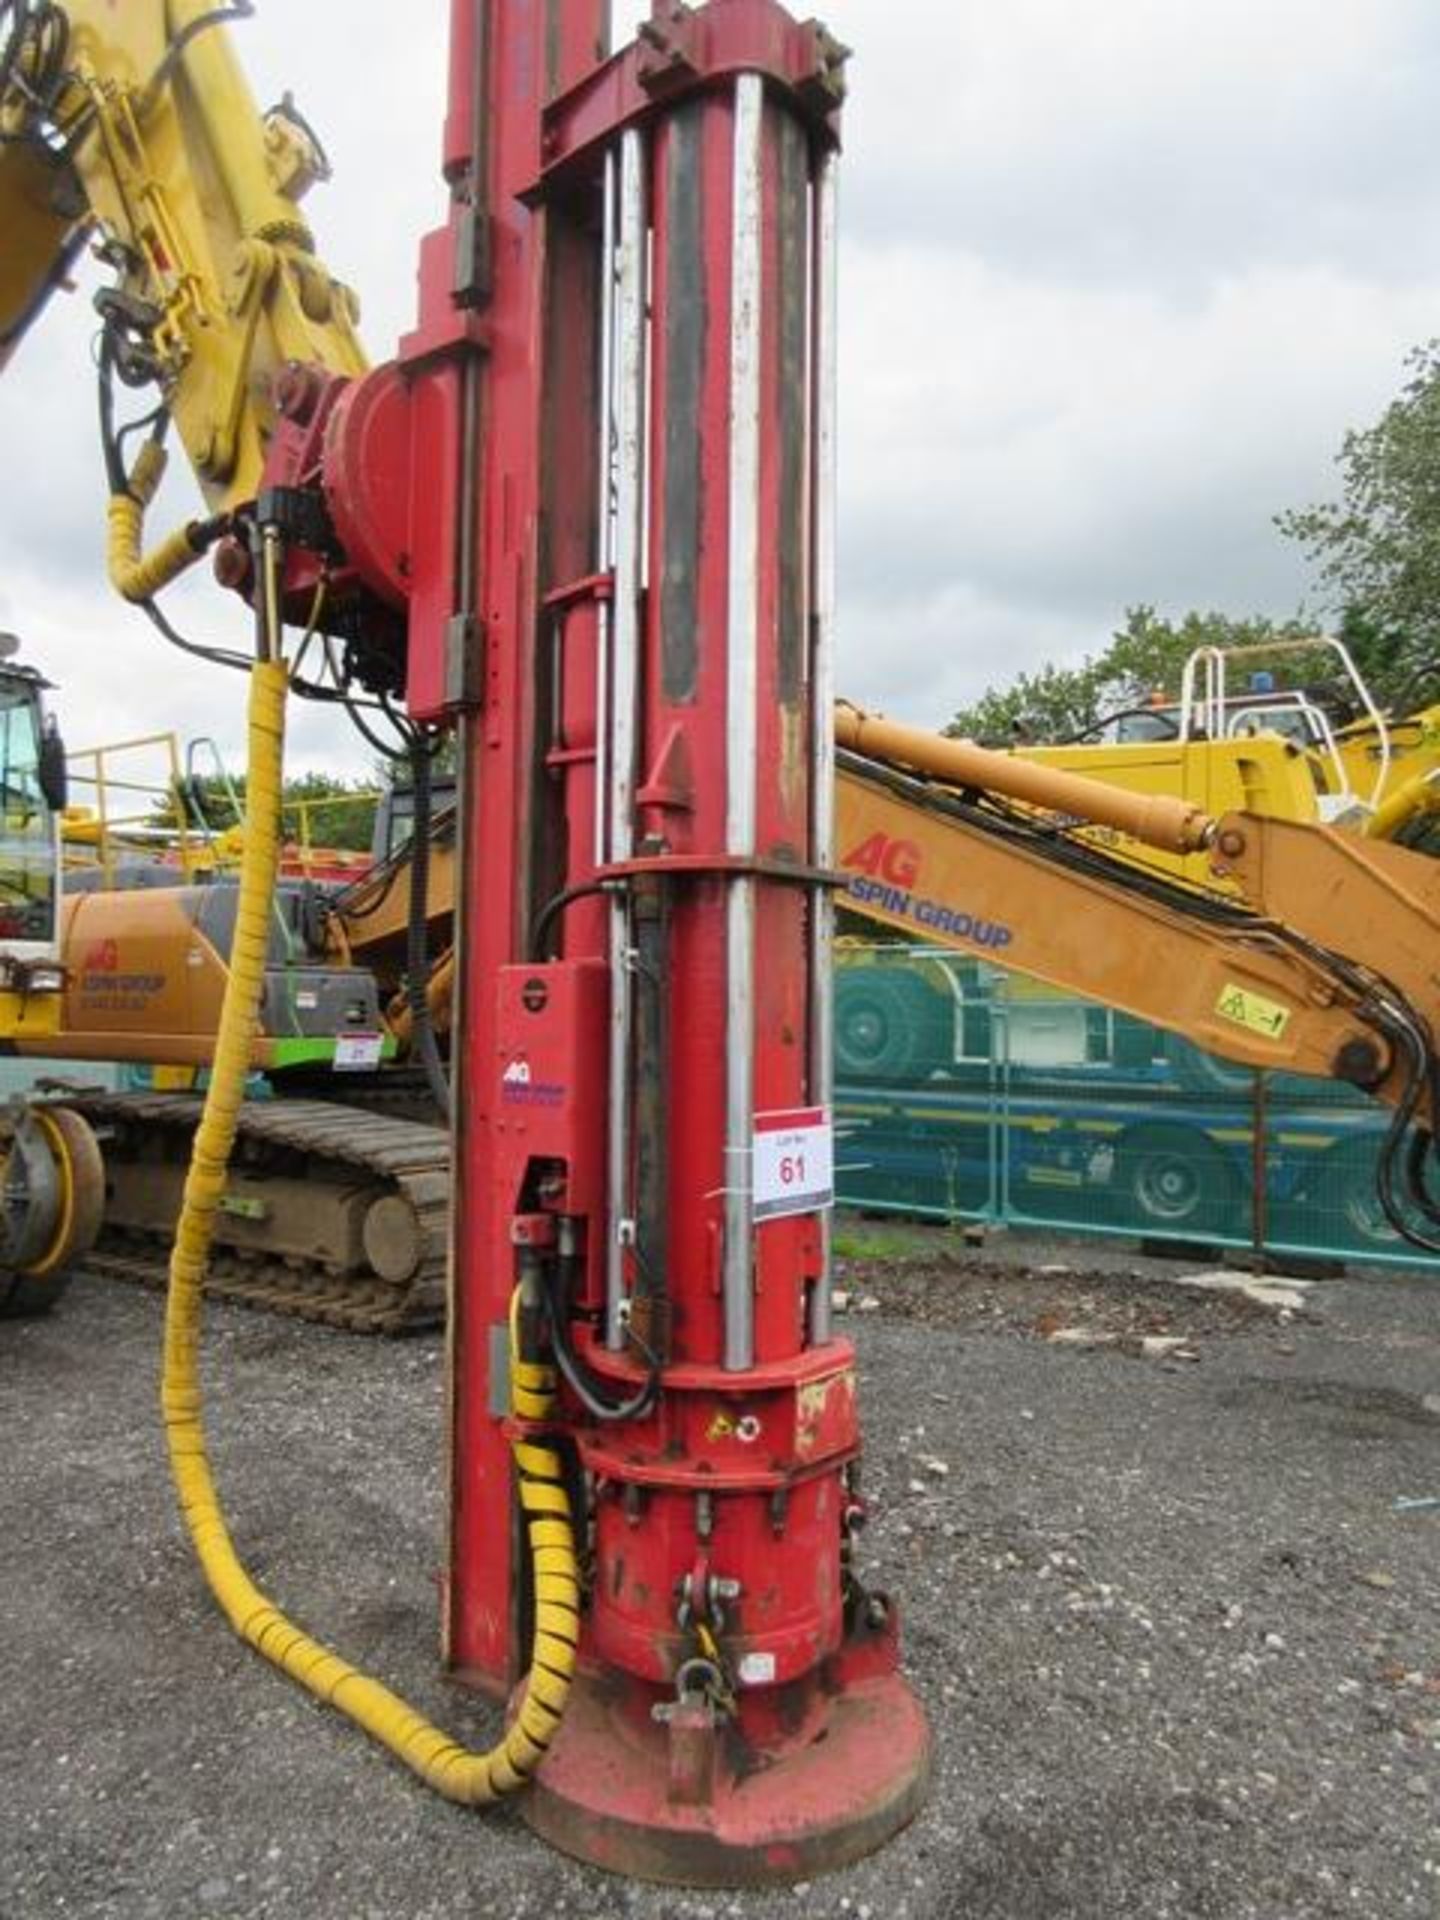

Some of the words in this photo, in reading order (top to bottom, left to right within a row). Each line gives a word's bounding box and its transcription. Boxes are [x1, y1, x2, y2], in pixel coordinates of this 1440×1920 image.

[841, 831, 921, 890] AG
[848, 876, 910, 915] SPIN
[914, 901, 1013, 949] GROUP
[779, 1154, 805, 1185] 61
